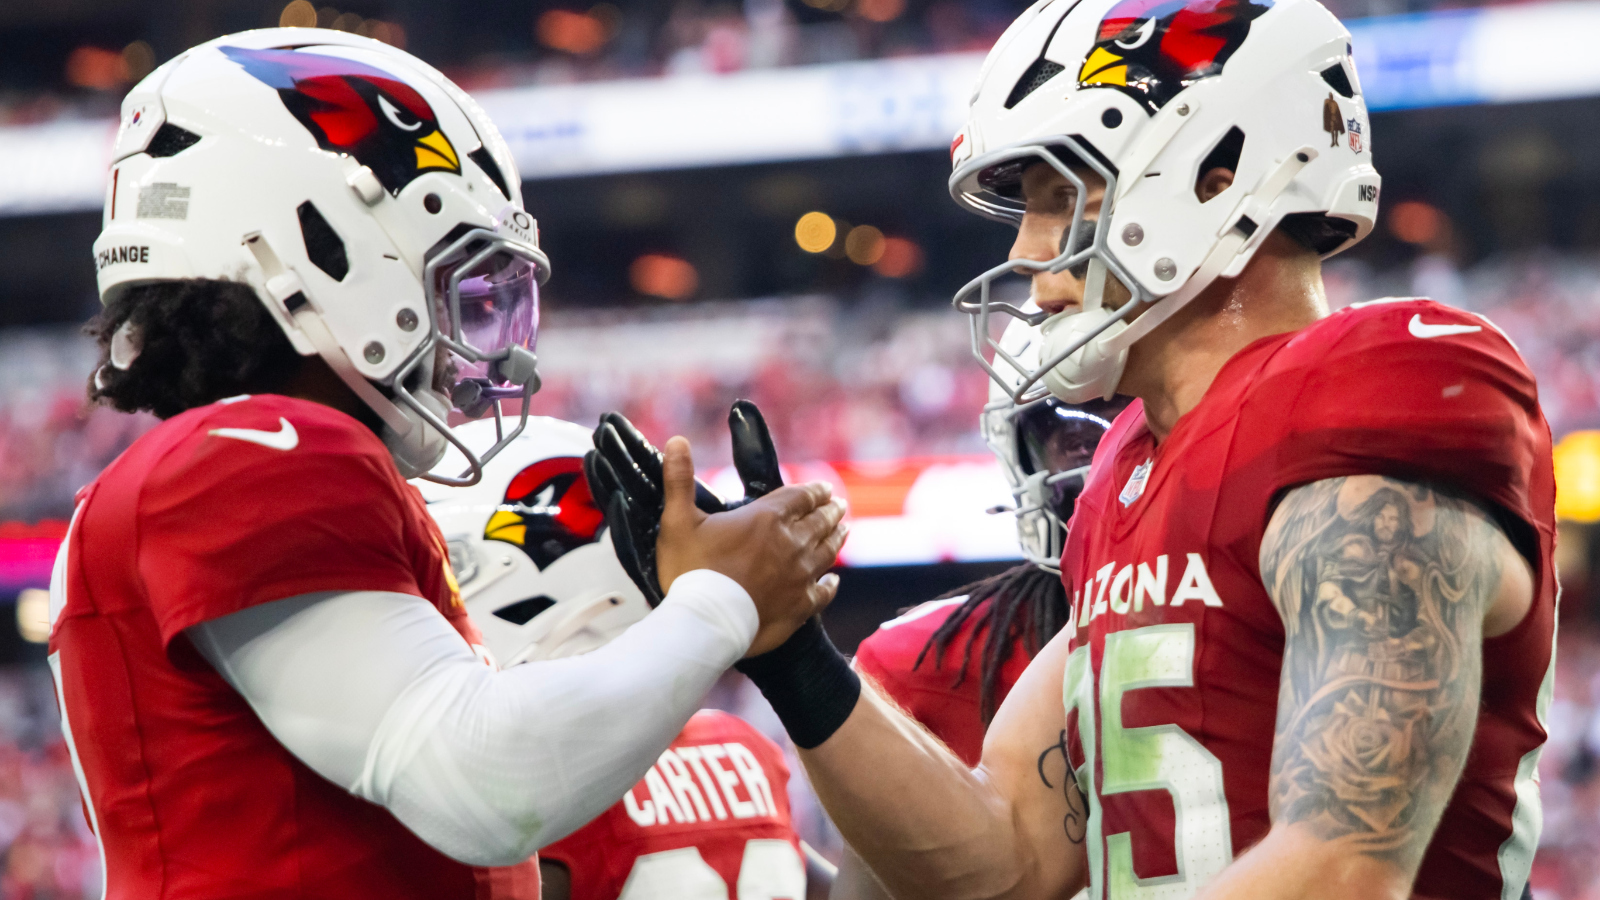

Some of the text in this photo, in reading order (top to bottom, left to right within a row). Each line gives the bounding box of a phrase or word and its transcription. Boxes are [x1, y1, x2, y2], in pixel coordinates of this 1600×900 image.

[99, 245, 149, 269] CHANGE
[1070, 552, 1224, 639] IZONA
[622, 742, 778, 827] CARTER
